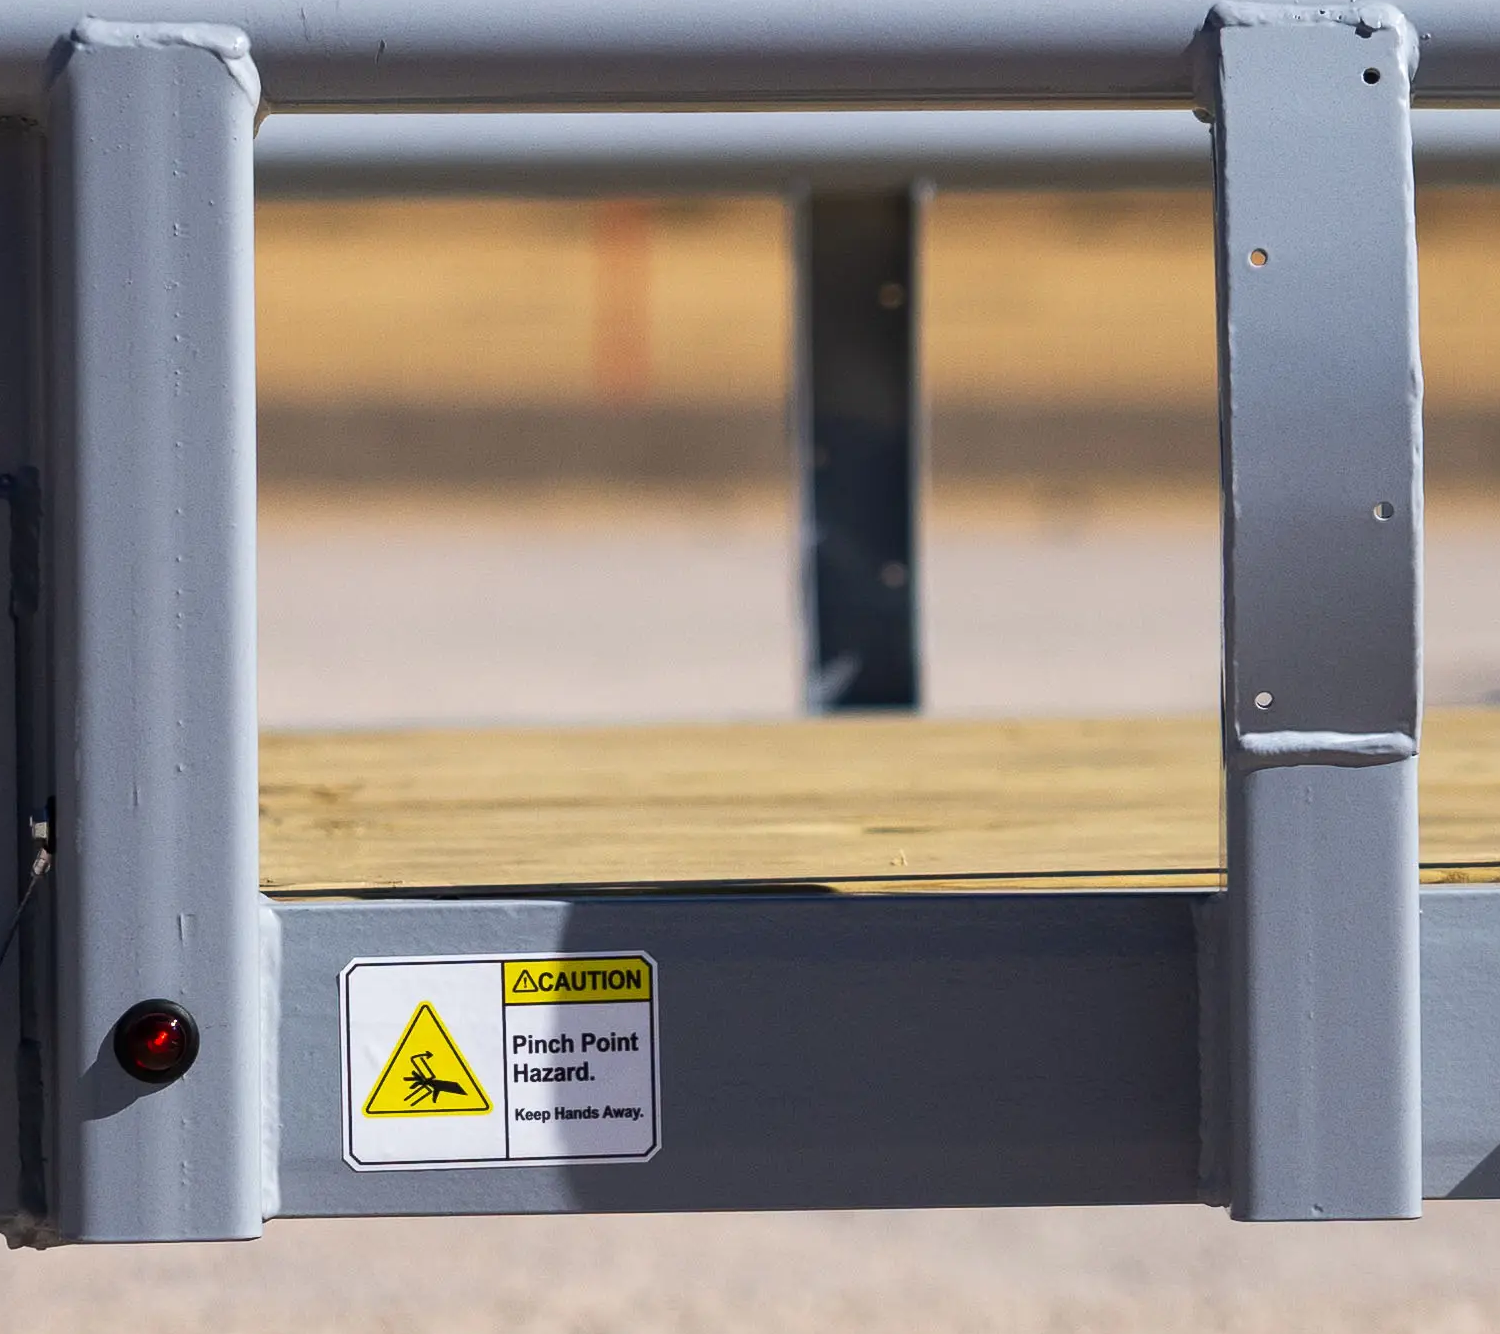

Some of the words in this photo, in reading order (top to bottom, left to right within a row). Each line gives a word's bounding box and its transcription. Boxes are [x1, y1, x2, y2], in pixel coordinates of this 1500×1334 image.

[538, 969, 642, 992] CAUTION
[512, 1033, 575, 1055] Pinch
[581, 1032, 639, 1053] Point
[513, 1062, 596, 1083] Hazard.
[514, 1108, 551, 1123] Keep
[554, 1106, 600, 1120] Hands
[602, 1105, 645, 1121] Away.
